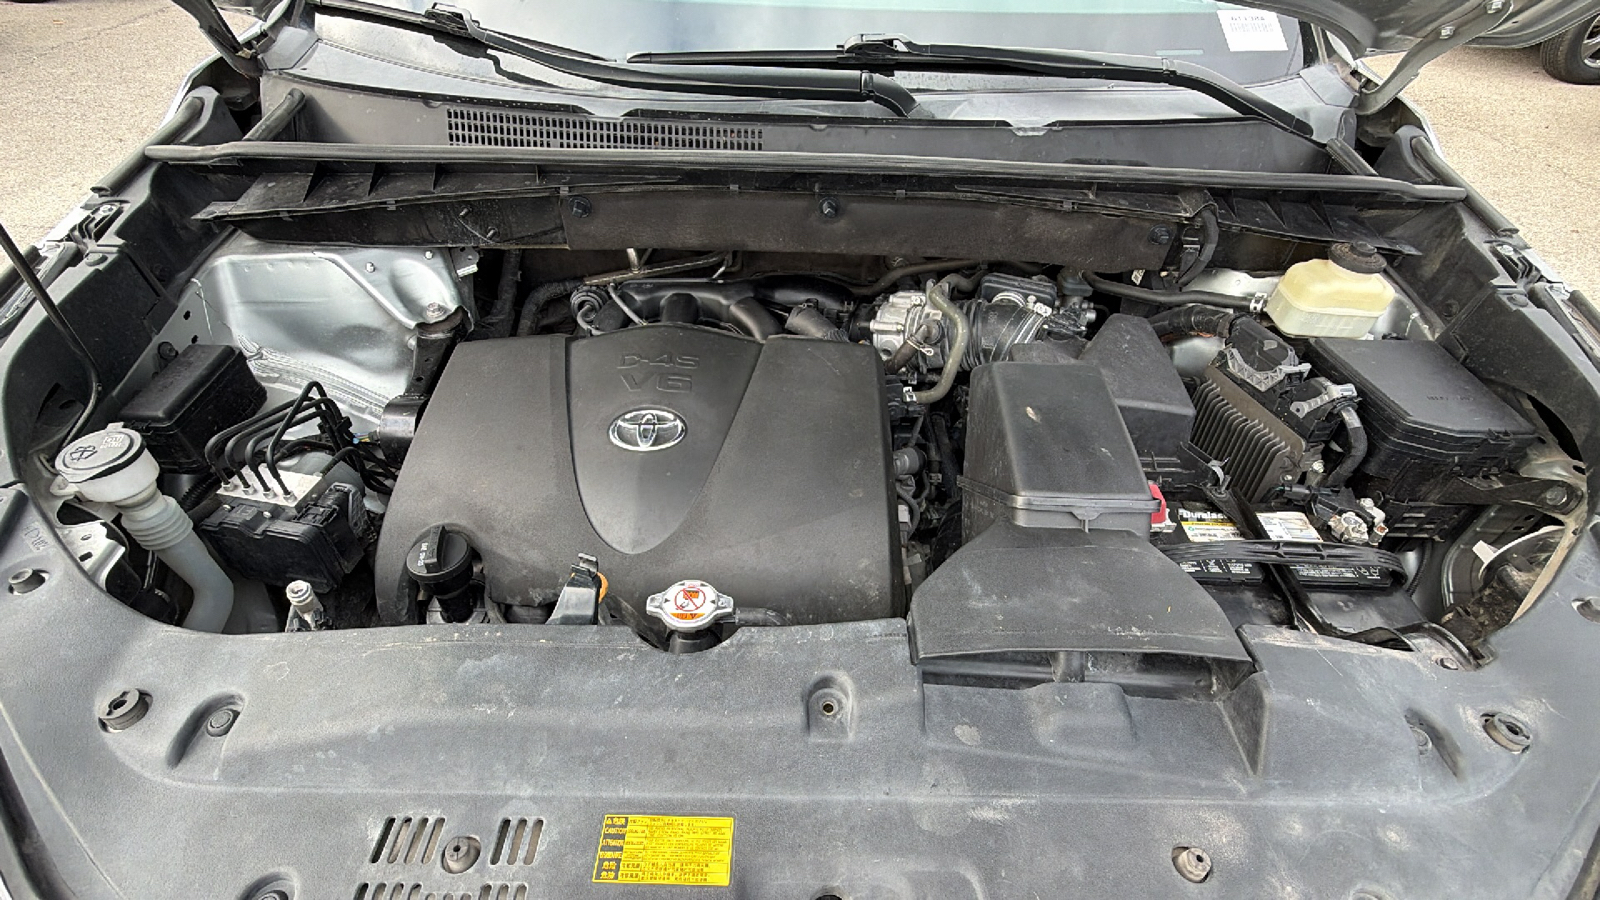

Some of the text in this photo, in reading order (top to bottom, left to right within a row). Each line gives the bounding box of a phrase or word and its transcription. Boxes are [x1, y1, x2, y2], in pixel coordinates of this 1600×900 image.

[617, 354, 700, 369] D-4S
[620, 373, 693, 393] V6
[1182, 510, 1228, 519] Duralas
